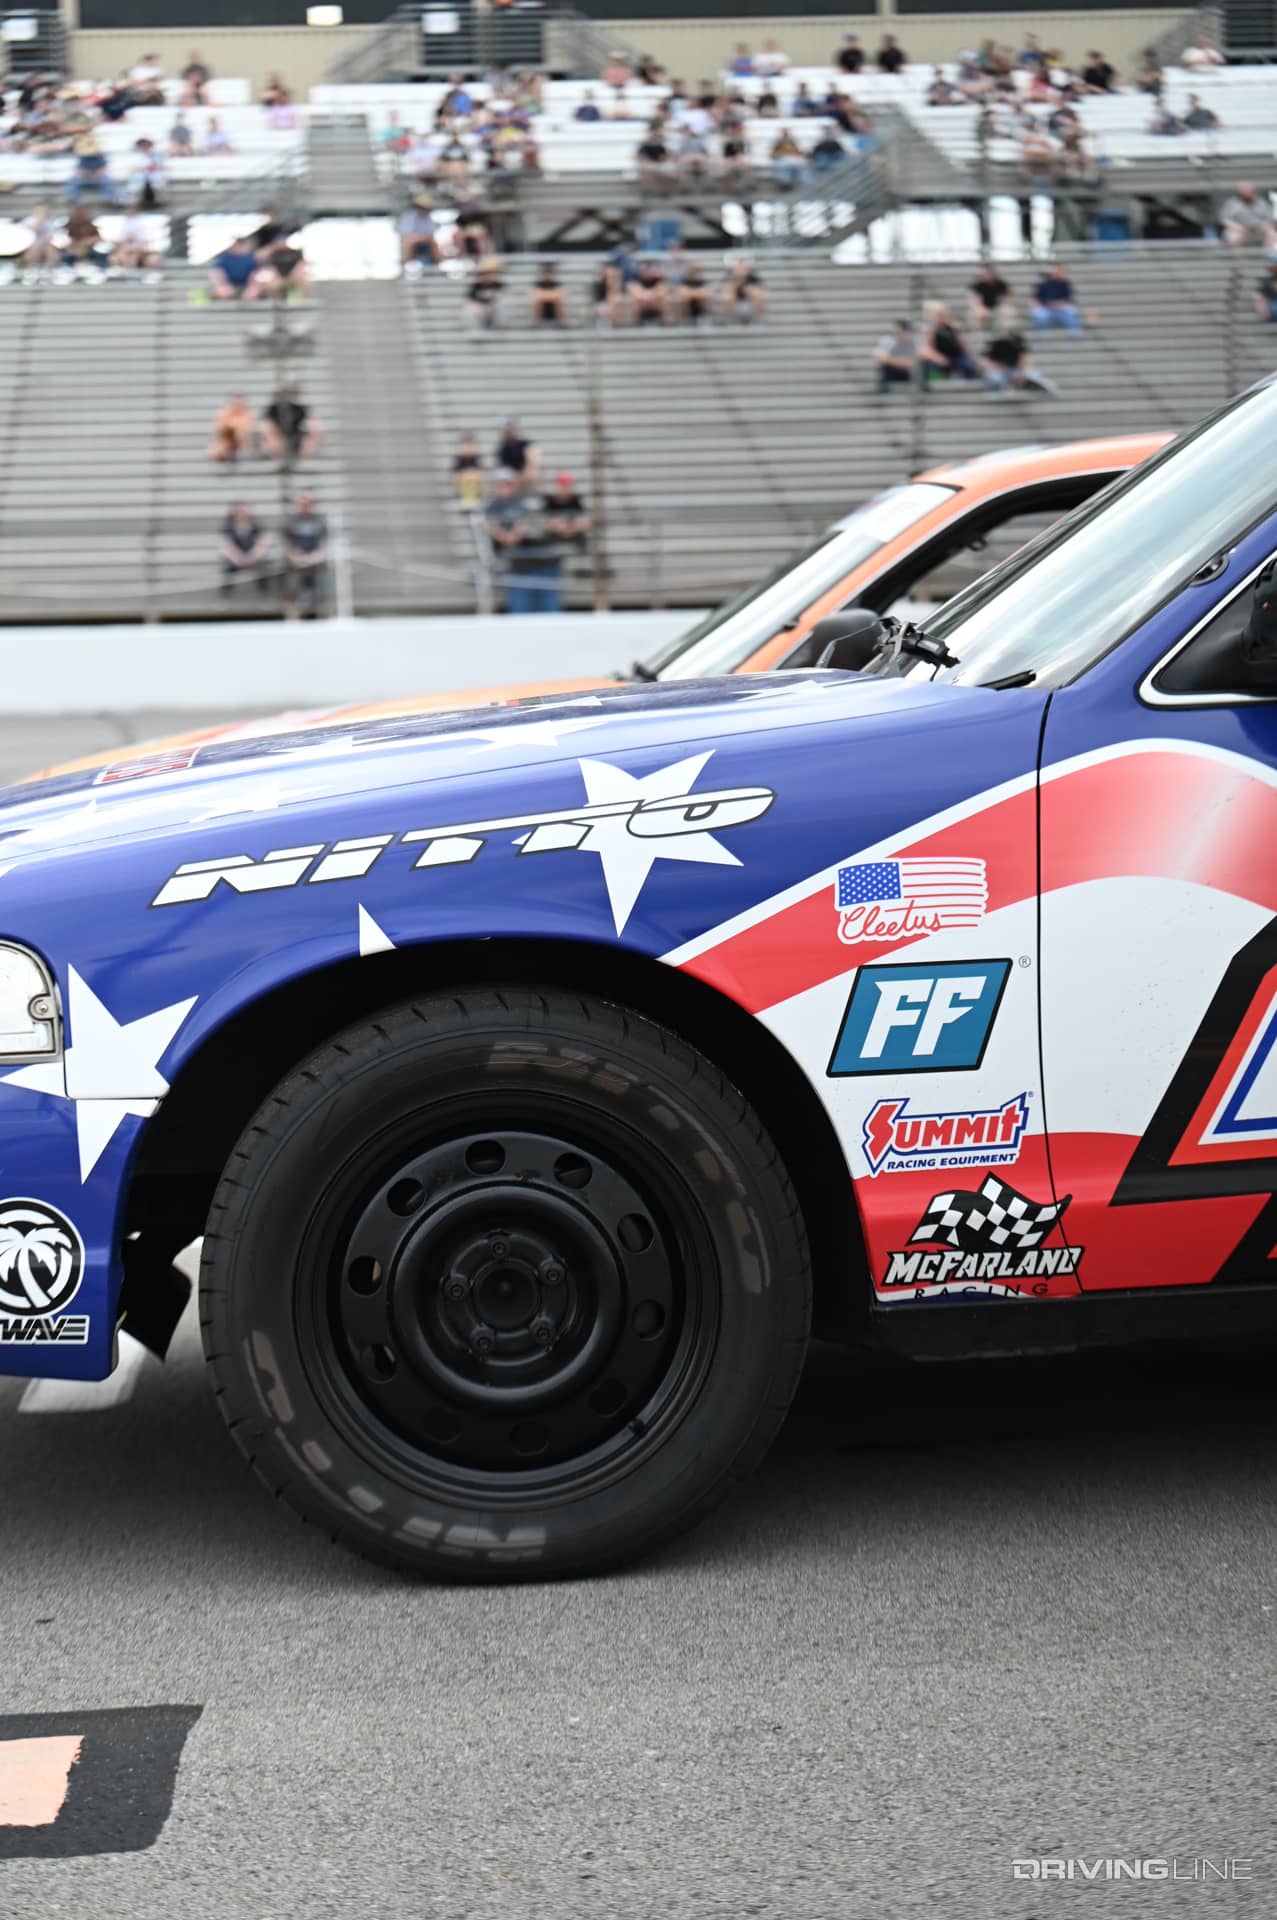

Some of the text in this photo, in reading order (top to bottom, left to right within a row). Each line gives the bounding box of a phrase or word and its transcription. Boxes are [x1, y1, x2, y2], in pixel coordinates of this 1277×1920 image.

[147, 787, 777, 908] NITTO
[841, 900, 942, 939] Cleetus
[859, 976, 987, 1058] FF
[887, 1153, 1016, 1169] RACING EQUIPMENT
